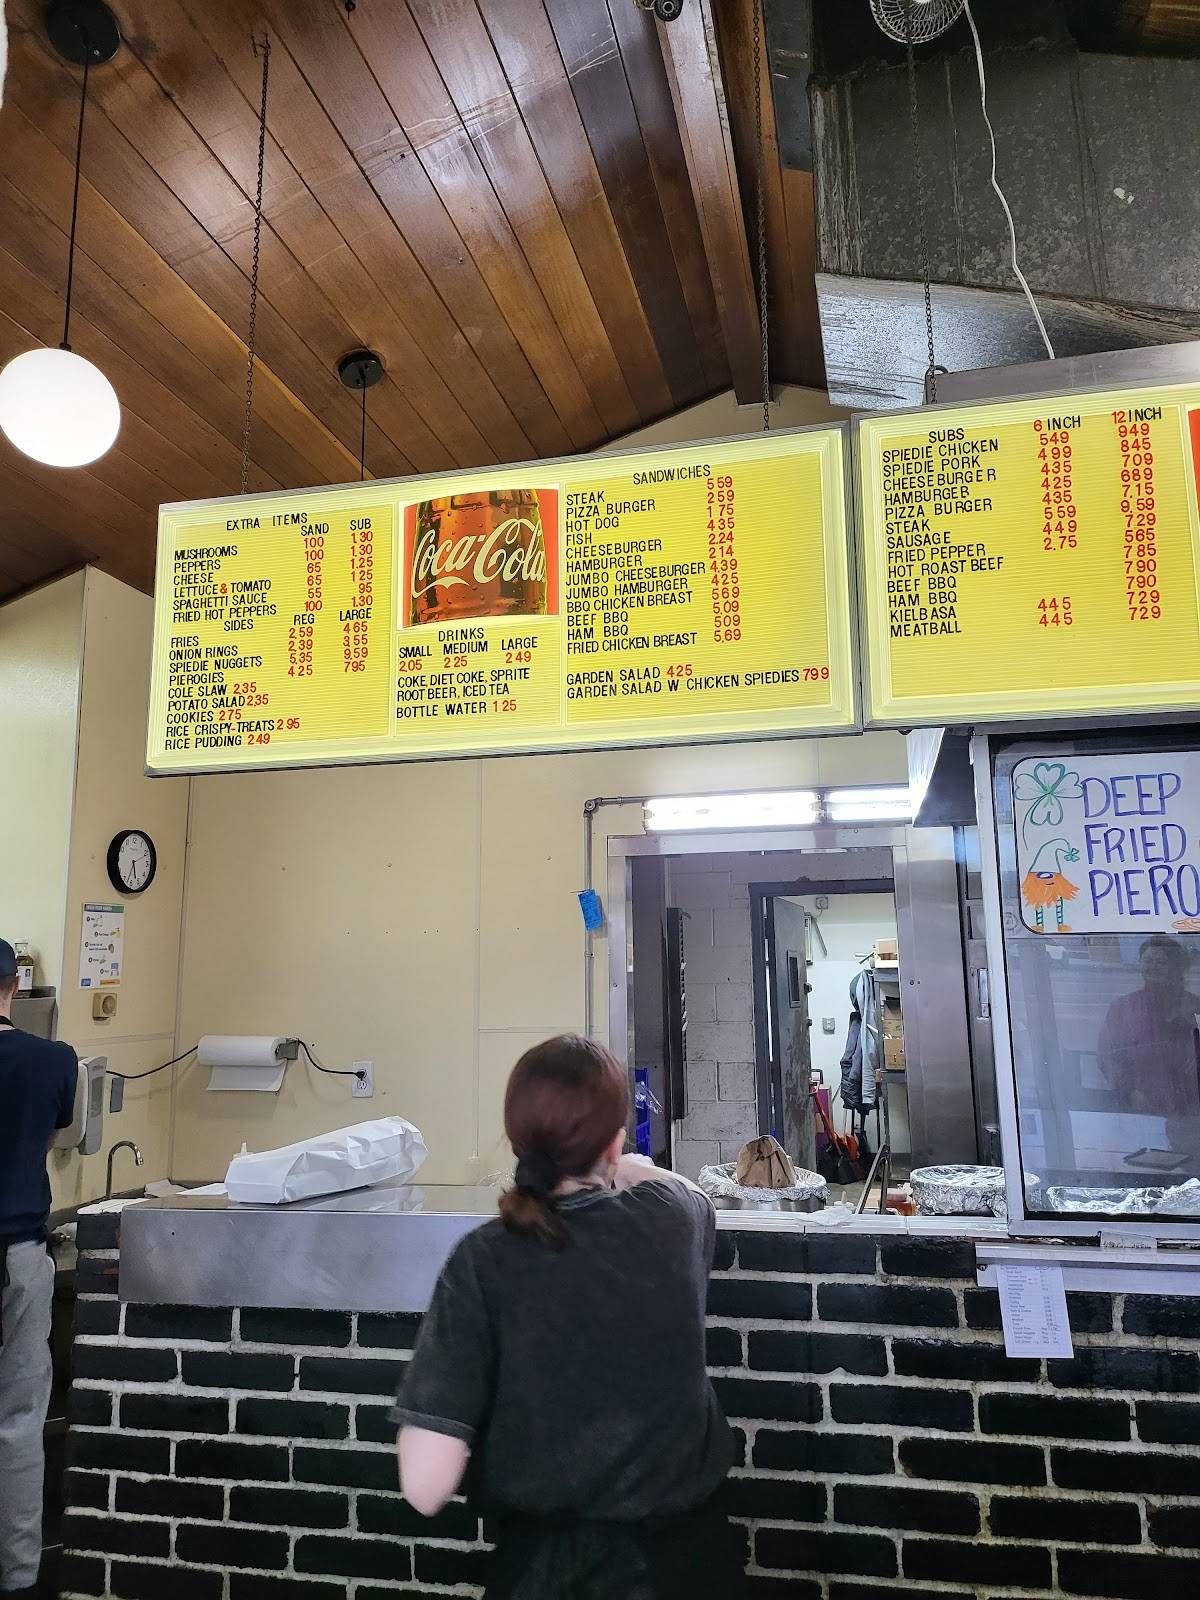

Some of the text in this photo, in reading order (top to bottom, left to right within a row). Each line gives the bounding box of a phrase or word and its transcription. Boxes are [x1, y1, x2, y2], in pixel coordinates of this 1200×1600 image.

[928, 406, 1162, 444] SUBS 6 INCH 12 INCH
[883, 423, 1150, 463] SPIEDIE CHICKEN 549 949
[883, 437, 1151, 477] SPIEDIE PORK 845
[1122, 452, 1153, 468] 709
[633, 464, 711, 485] SANDWICHES
[1121, 467, 1153, 482] 689
[566, 491, 605, 505] STEAK
[566, 499, 656, 519] PIZZA BURGER
[885, 482, 1154, 521] PIZZA BURGER 7.15
[226, 513, 308, 531] EXTRA ITEMS
[301, 518, 371, 536] SAND SUB
[566, 517, 620, 533] HOT DOG
[886, 497, 1155, 535] STEAK 9.59
[174, 531, 373, 561] MUSHROOMS 100 1.30
[566, 532, 592, 546] FISH
[566, 531, 734, 559] CHEESEBURGER 2.24
[887, 531, 951, 549] SAUSAGE
[888, 528, 1155, 564] FRIED PEPPER 2.75 565
[174, 544, 373, 573] PEPPERS 100 1.30
[412, 518, 547, 598] Coca-Cola
[566, 555, 642, 573] HAMBURGER
[888, 556, 1004, 579] HOT ROAST BEEF
[173, 556, 373, 586] CHEESE 65 1.25
[566, 558, 738, 586] JUMBO CHEESEBURGER 4.39
[174, 575, 322, 598] LETTUCE & TOMATO 65
[566, 585, 608, 600] JUMBO
[614, 578, 689, 596] HAMBURGER
[887, 579, 921, 593] BEEF
[928, 576, 957, 591] BBQ
[173, 582, 372, 610] SPAGHETTI SAUCE 55 95
[567, 586, 740, 613] BBQ CHICKEN BREAST 569
[888, 593, 920, 608] HAM
[928, 591, 958, 606] BBQ
[173, 595, 373, 623] FRIED HOT PEPPERS 100 1.30
[223, 608, 372, 632] SIDES REG LARGE
[567, 600, 739, 627] BEEF BBQ 5.09
[890, 606, 957, 623] KIELBASA
[171, 626, 313, 648] FRIES 2.59
[438, 628, 484, 642] DRINKS
[567, 614, 740, 641] HAM BBQ 509
[890, 621, 962, 638] MEATBALL
[399, 637, 538, 658] SMALL MEDIUM LARGE
[567, 628, 741, 654] FRIED CHICKEN BREAST 5.69
[169, 648, 201, 661] ONION
[205, 646, 238, 658] RINGS
[169, 647, 368, 673] SPIEDIE NUGGETS 5.35 9.59
[169, 673, 225, 686] PIEROGIES
[344, 660, 365, 673] 795
[430, 673, 454, 686] DIET
[457, 671, 487, 684] COKE,
[491, 668, 530, 681] SPRITE
[567, 671, 614, 686] GARDEN
[619, 666, 661, 681] SALAD
[567, 667, 829, 699] GARDEN SALAD W CHICKEN SPIEDIES 799
[168, 684, 228, 699] COLE SLAW
[397, 683, 510, 701] ROOT BEER, ICED TEA
[168, 694, 269, 712] POTATO SALAD 2.35
[397, 702, 487, 718] BOTTLE WATER
[167, 711, 214, 724] COOKIES
[166, 720, 275, 738] RICE CRISPY-TREATS
[165, 735, 242, 751] RICE PUDDING
[1080, 773, 1182, 818] DEEP
[1084, 824, 1187, 864] FRIED
[1089, 864, 1200, 916] PIERO
